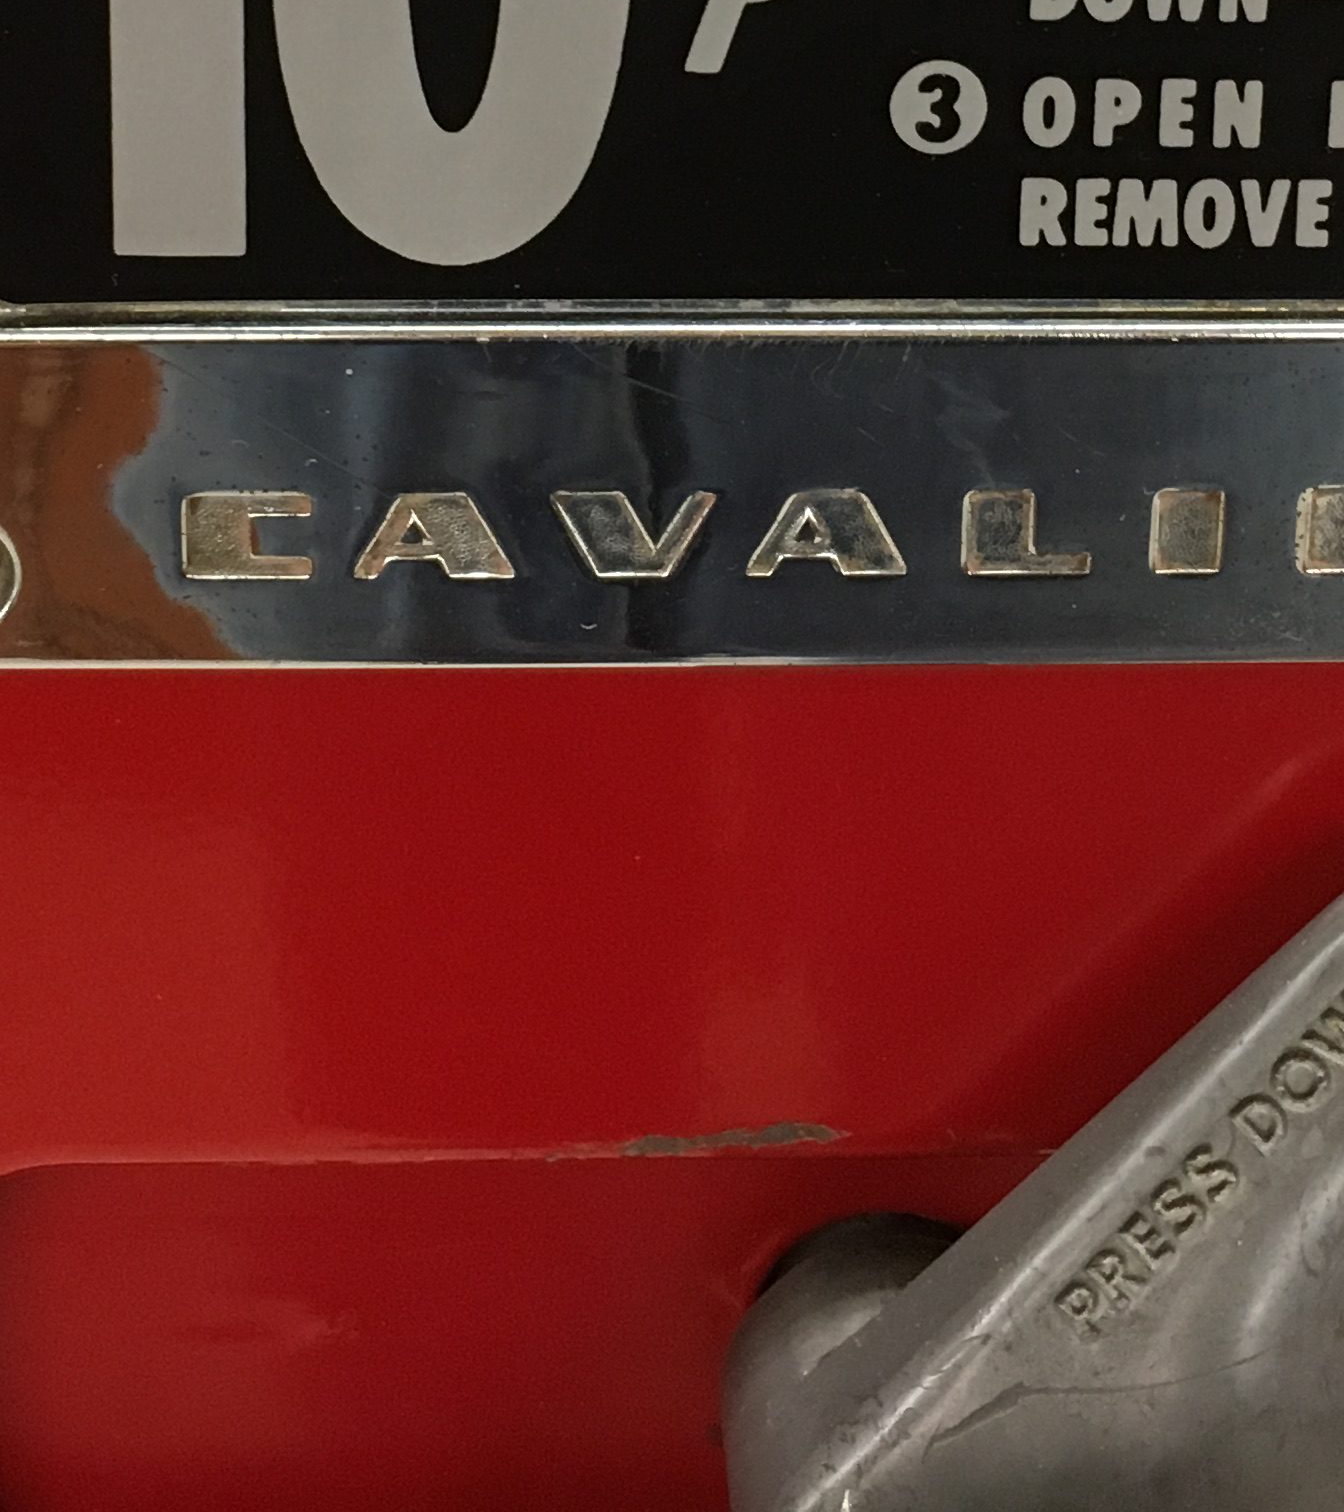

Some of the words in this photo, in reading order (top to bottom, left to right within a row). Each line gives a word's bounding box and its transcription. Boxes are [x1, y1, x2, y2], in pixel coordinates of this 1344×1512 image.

[1024, 77, 1262, 148] OPEN
[1020, 178, 1332, 248] REMOVE
[1055, 1143, 1239, 1341] PRESS
